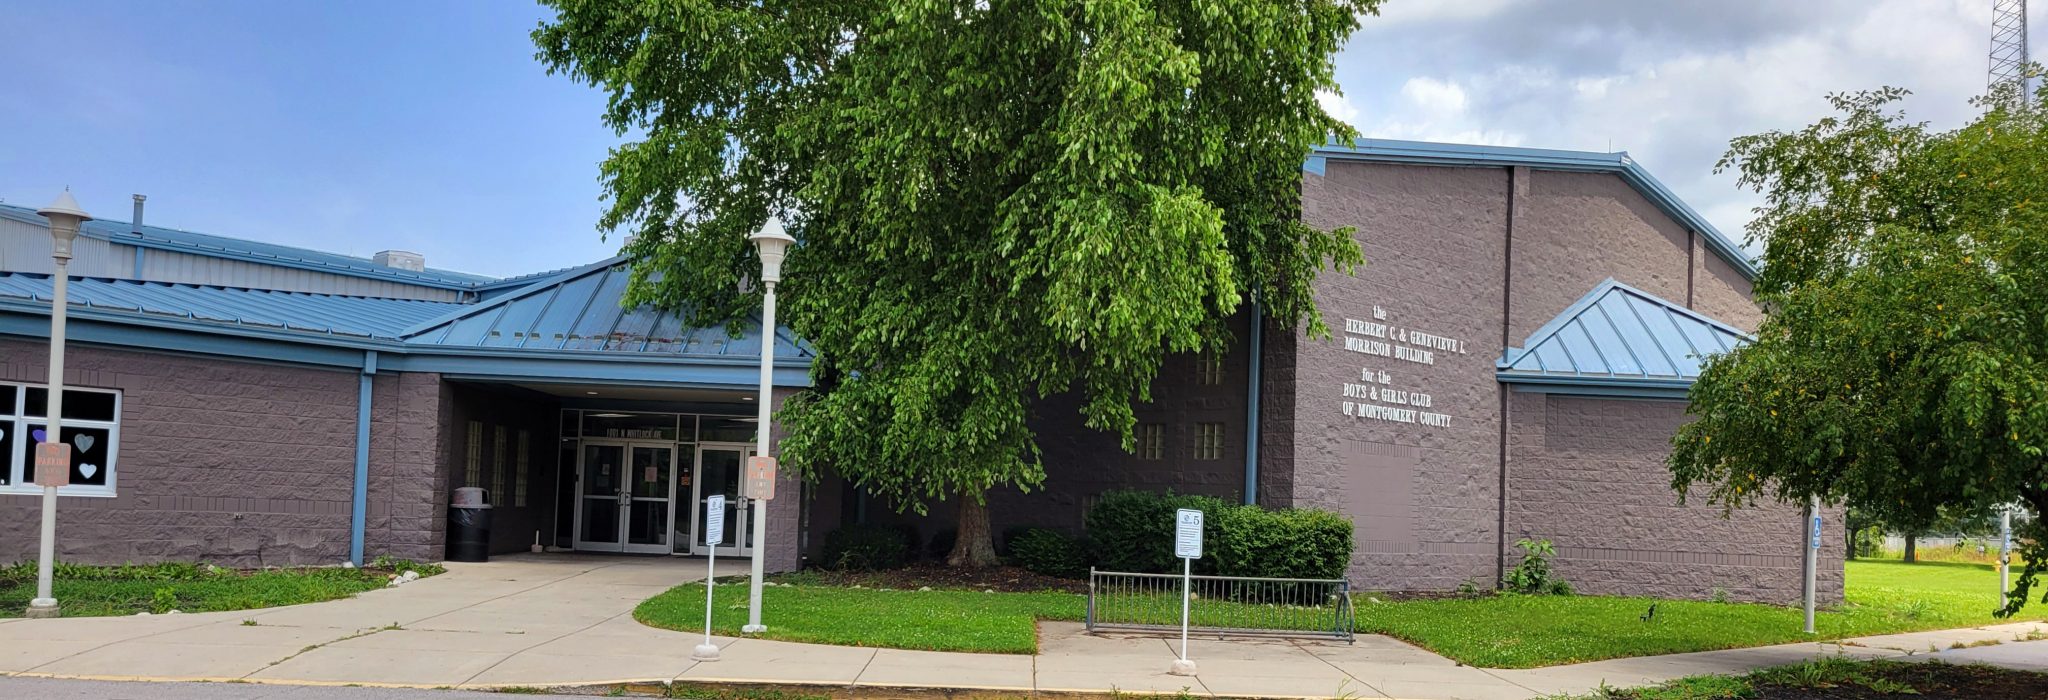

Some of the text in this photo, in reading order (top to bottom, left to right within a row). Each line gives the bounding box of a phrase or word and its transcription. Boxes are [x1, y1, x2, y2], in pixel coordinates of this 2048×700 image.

[1373, 305, 1387, 320] the
[1345, 318, 1387, 338] HERBERT
[1399, 328, 1407, 342] &
[1410, 331, 1457, 352] GENEVIEVE
[1344, 336, 1434, 365] MORRISON BUILDING
[1362, 367, 1391, 384] for the
[1343, 383, 1432, 408] BOYS & GIRLS CLUB
[1342, 401, 1452, 428] OF MONTGOMERY COUNTY
[1193, 515, 1200, 526] 5
